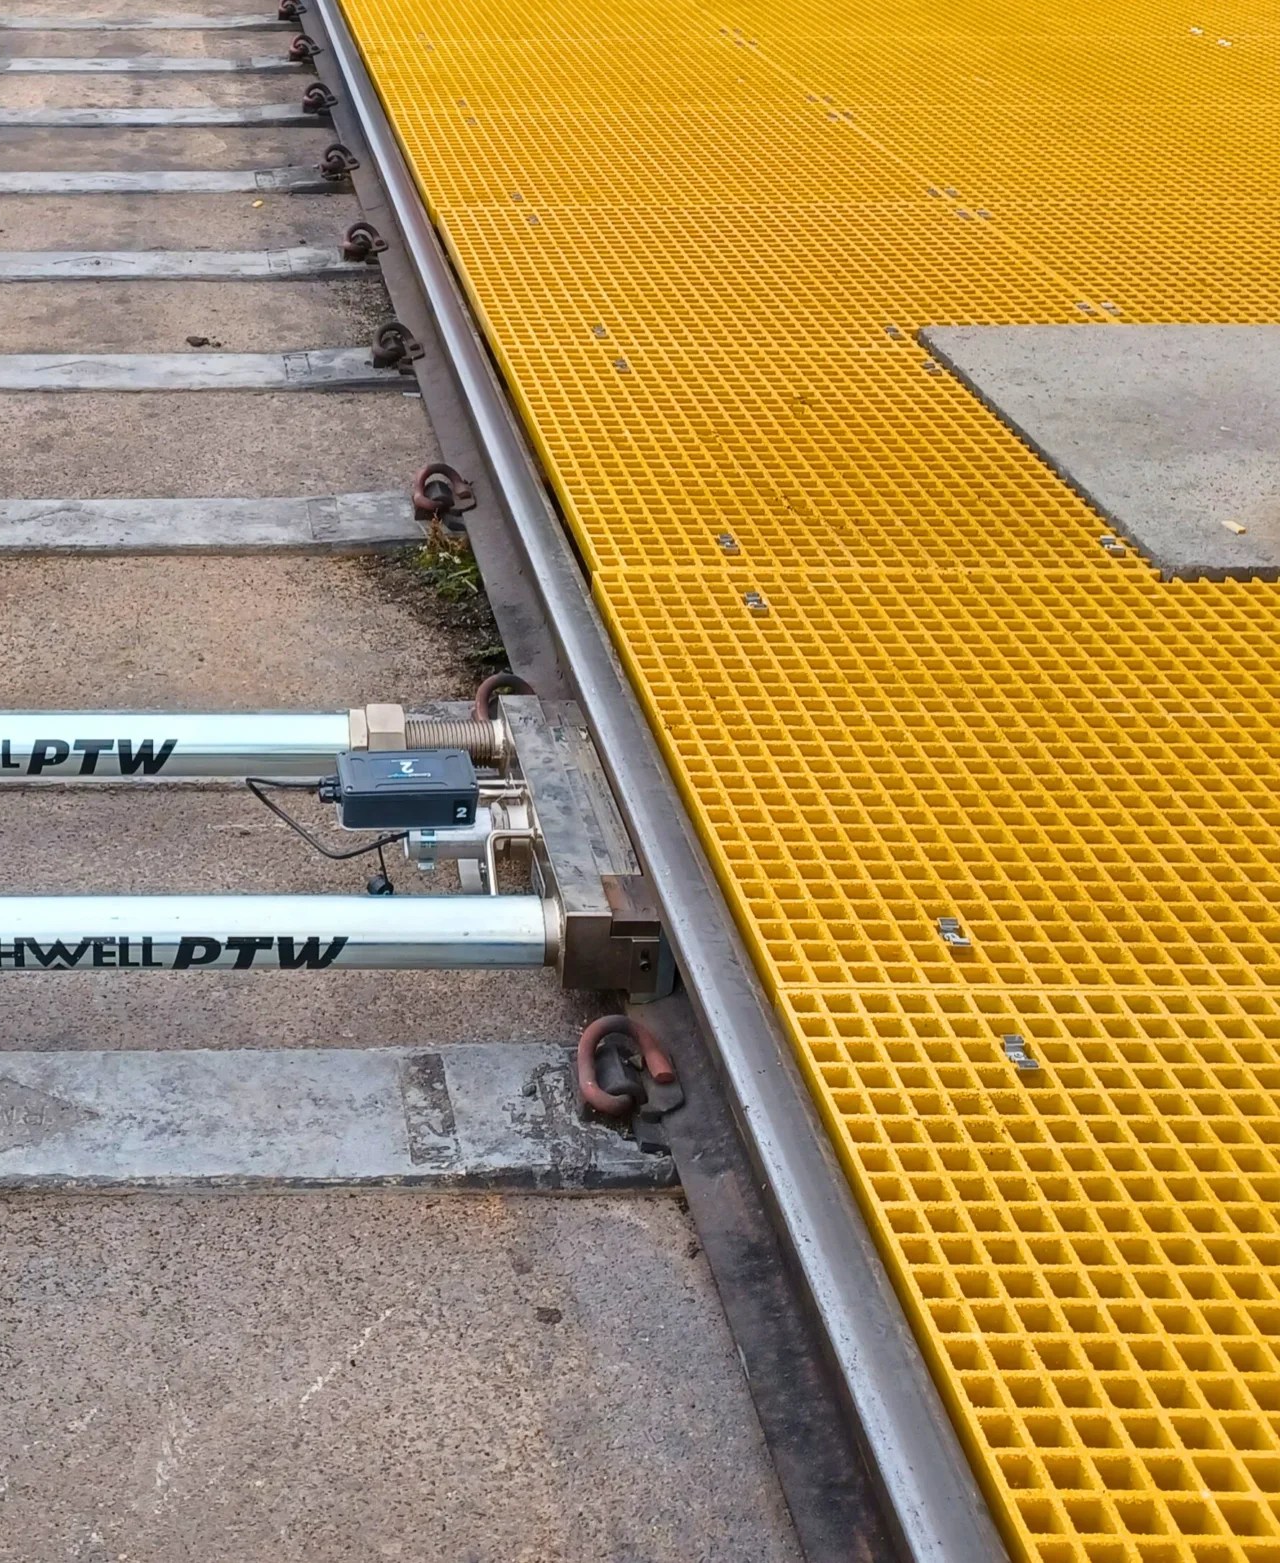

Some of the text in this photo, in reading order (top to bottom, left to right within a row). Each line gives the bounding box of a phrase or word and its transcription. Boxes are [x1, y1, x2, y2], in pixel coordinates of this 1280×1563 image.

[25, 738, 179, 775] PTW
[399, 760, 414, 773] 2
[456, 806, 467, 818] 2
[171, 935, 350, 970] PTW
